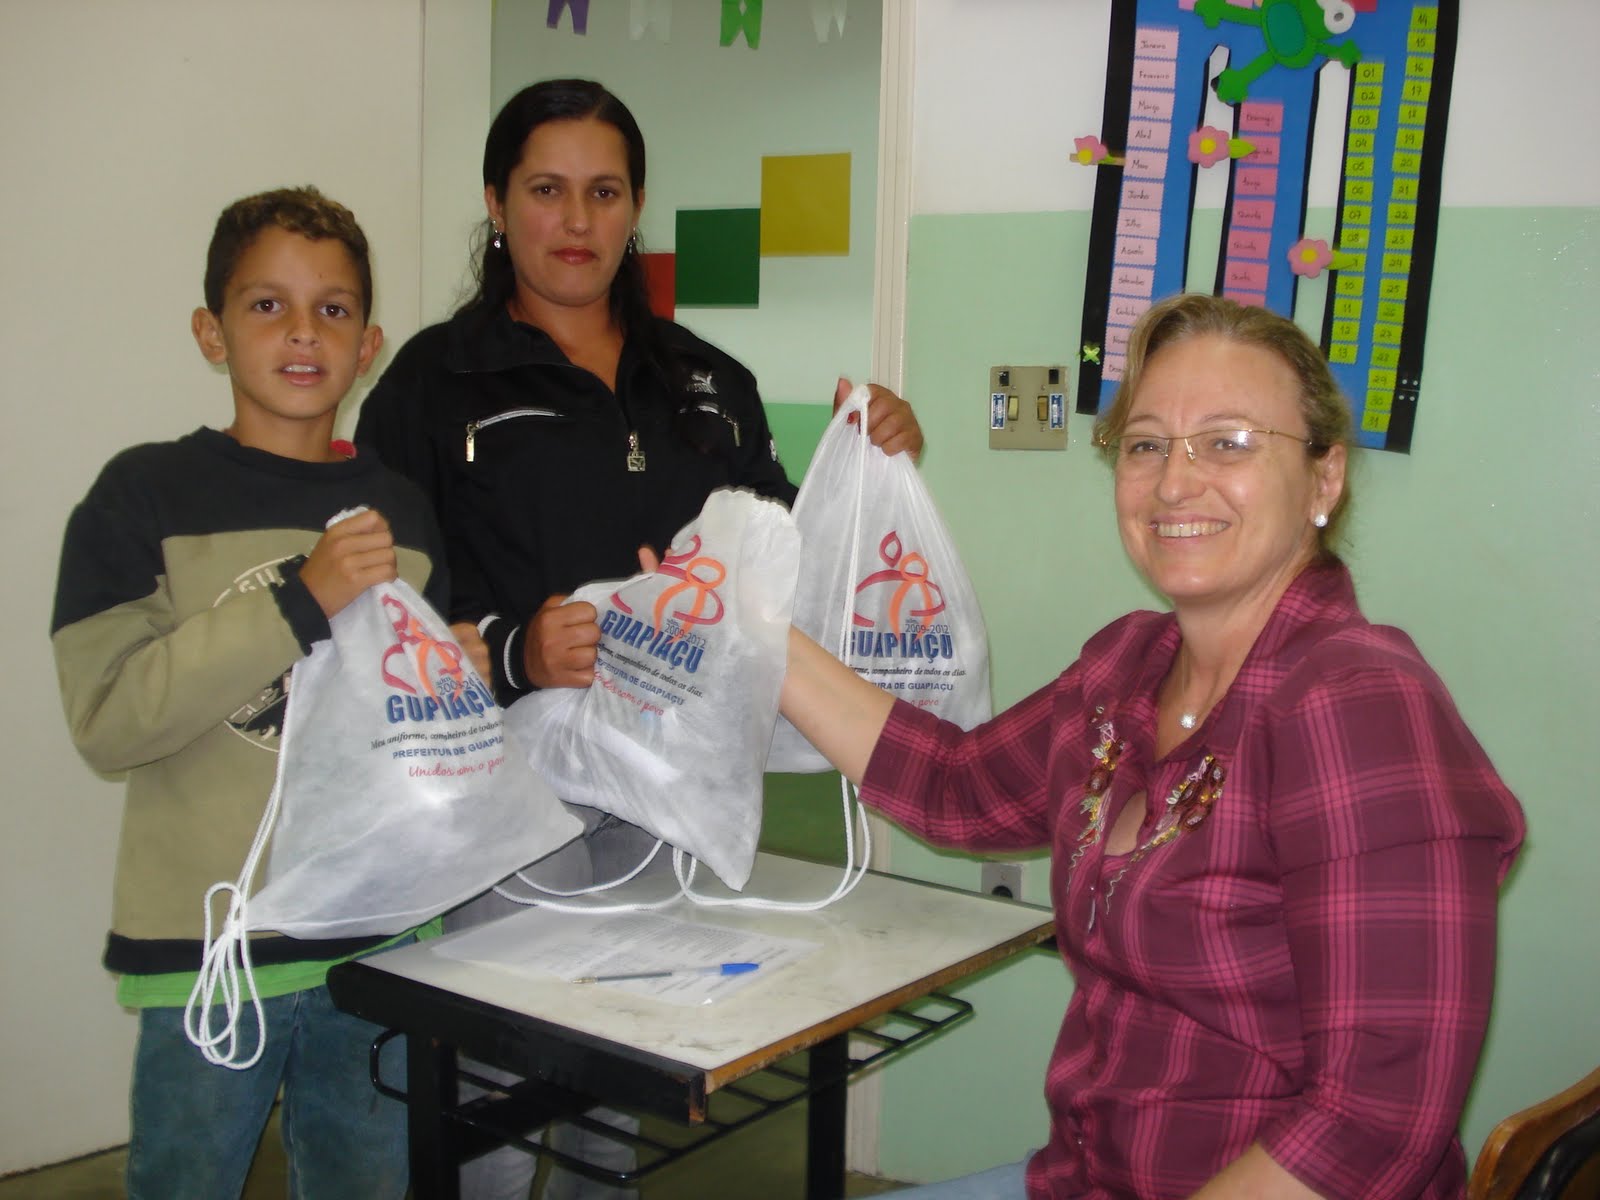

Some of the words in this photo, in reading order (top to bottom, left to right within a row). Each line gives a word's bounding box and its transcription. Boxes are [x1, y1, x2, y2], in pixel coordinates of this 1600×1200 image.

[1415, 37, 1426, 47] 15
[1414, 63, 1423, 73] 16
[1363, 69, 1375, 78] 01
[1361, 91, 1375, 101] 02
[1411, 86, 1422, 96] 17
[1358, 115, 1370, 125] 03
[1355, 139, 1366, 148] 04
[1405, 133, 1415, 145] 19
[1353, 162, 1364, 171] 05
[1400, 158, 1412, 167] 20
[1351, 186, 1363, 195] 06
[1398, 185, 1409, 194] 21
[1349, 210, 1361, 220] 07
[1394, 210, 1409, 220] 22
[1347, 233, 1360, 244] 08
[1391, 234, 1405, 244] 23
[1389, 257, 1402, 268] 24
[1386, 284, 1400, 294] 25
[1343, 304, 1352, 313] 11
[1341, 325, 1351, 335] 12
[1338, 347, 1347, 358] 13
[1373, 375, 1387, 386] 29
[1369, 416, 1379, 428] 31
[905, 623, 949, 634] 2009-2012
[664, 623, 706, 649] 2009-2012
[600, 610, 704, 673] GUAPIAÇU
[614, 653, 651, 673] companheiro
[651, 668, 660, 677] de
[659, 673, 679, 686] todos
[678, 682, 687, 690] os
[629, 675, 640, 686] DE
[639, 681, 686, 706] GUAPIAÇU
[894, 682, 905, 690] DE
[907, 682, 953, 692] GUAPIAÇU
[639, 702, 664, 716] povo
[468, 726, 478, 736] de
[454, 746, 466, 755] DE
